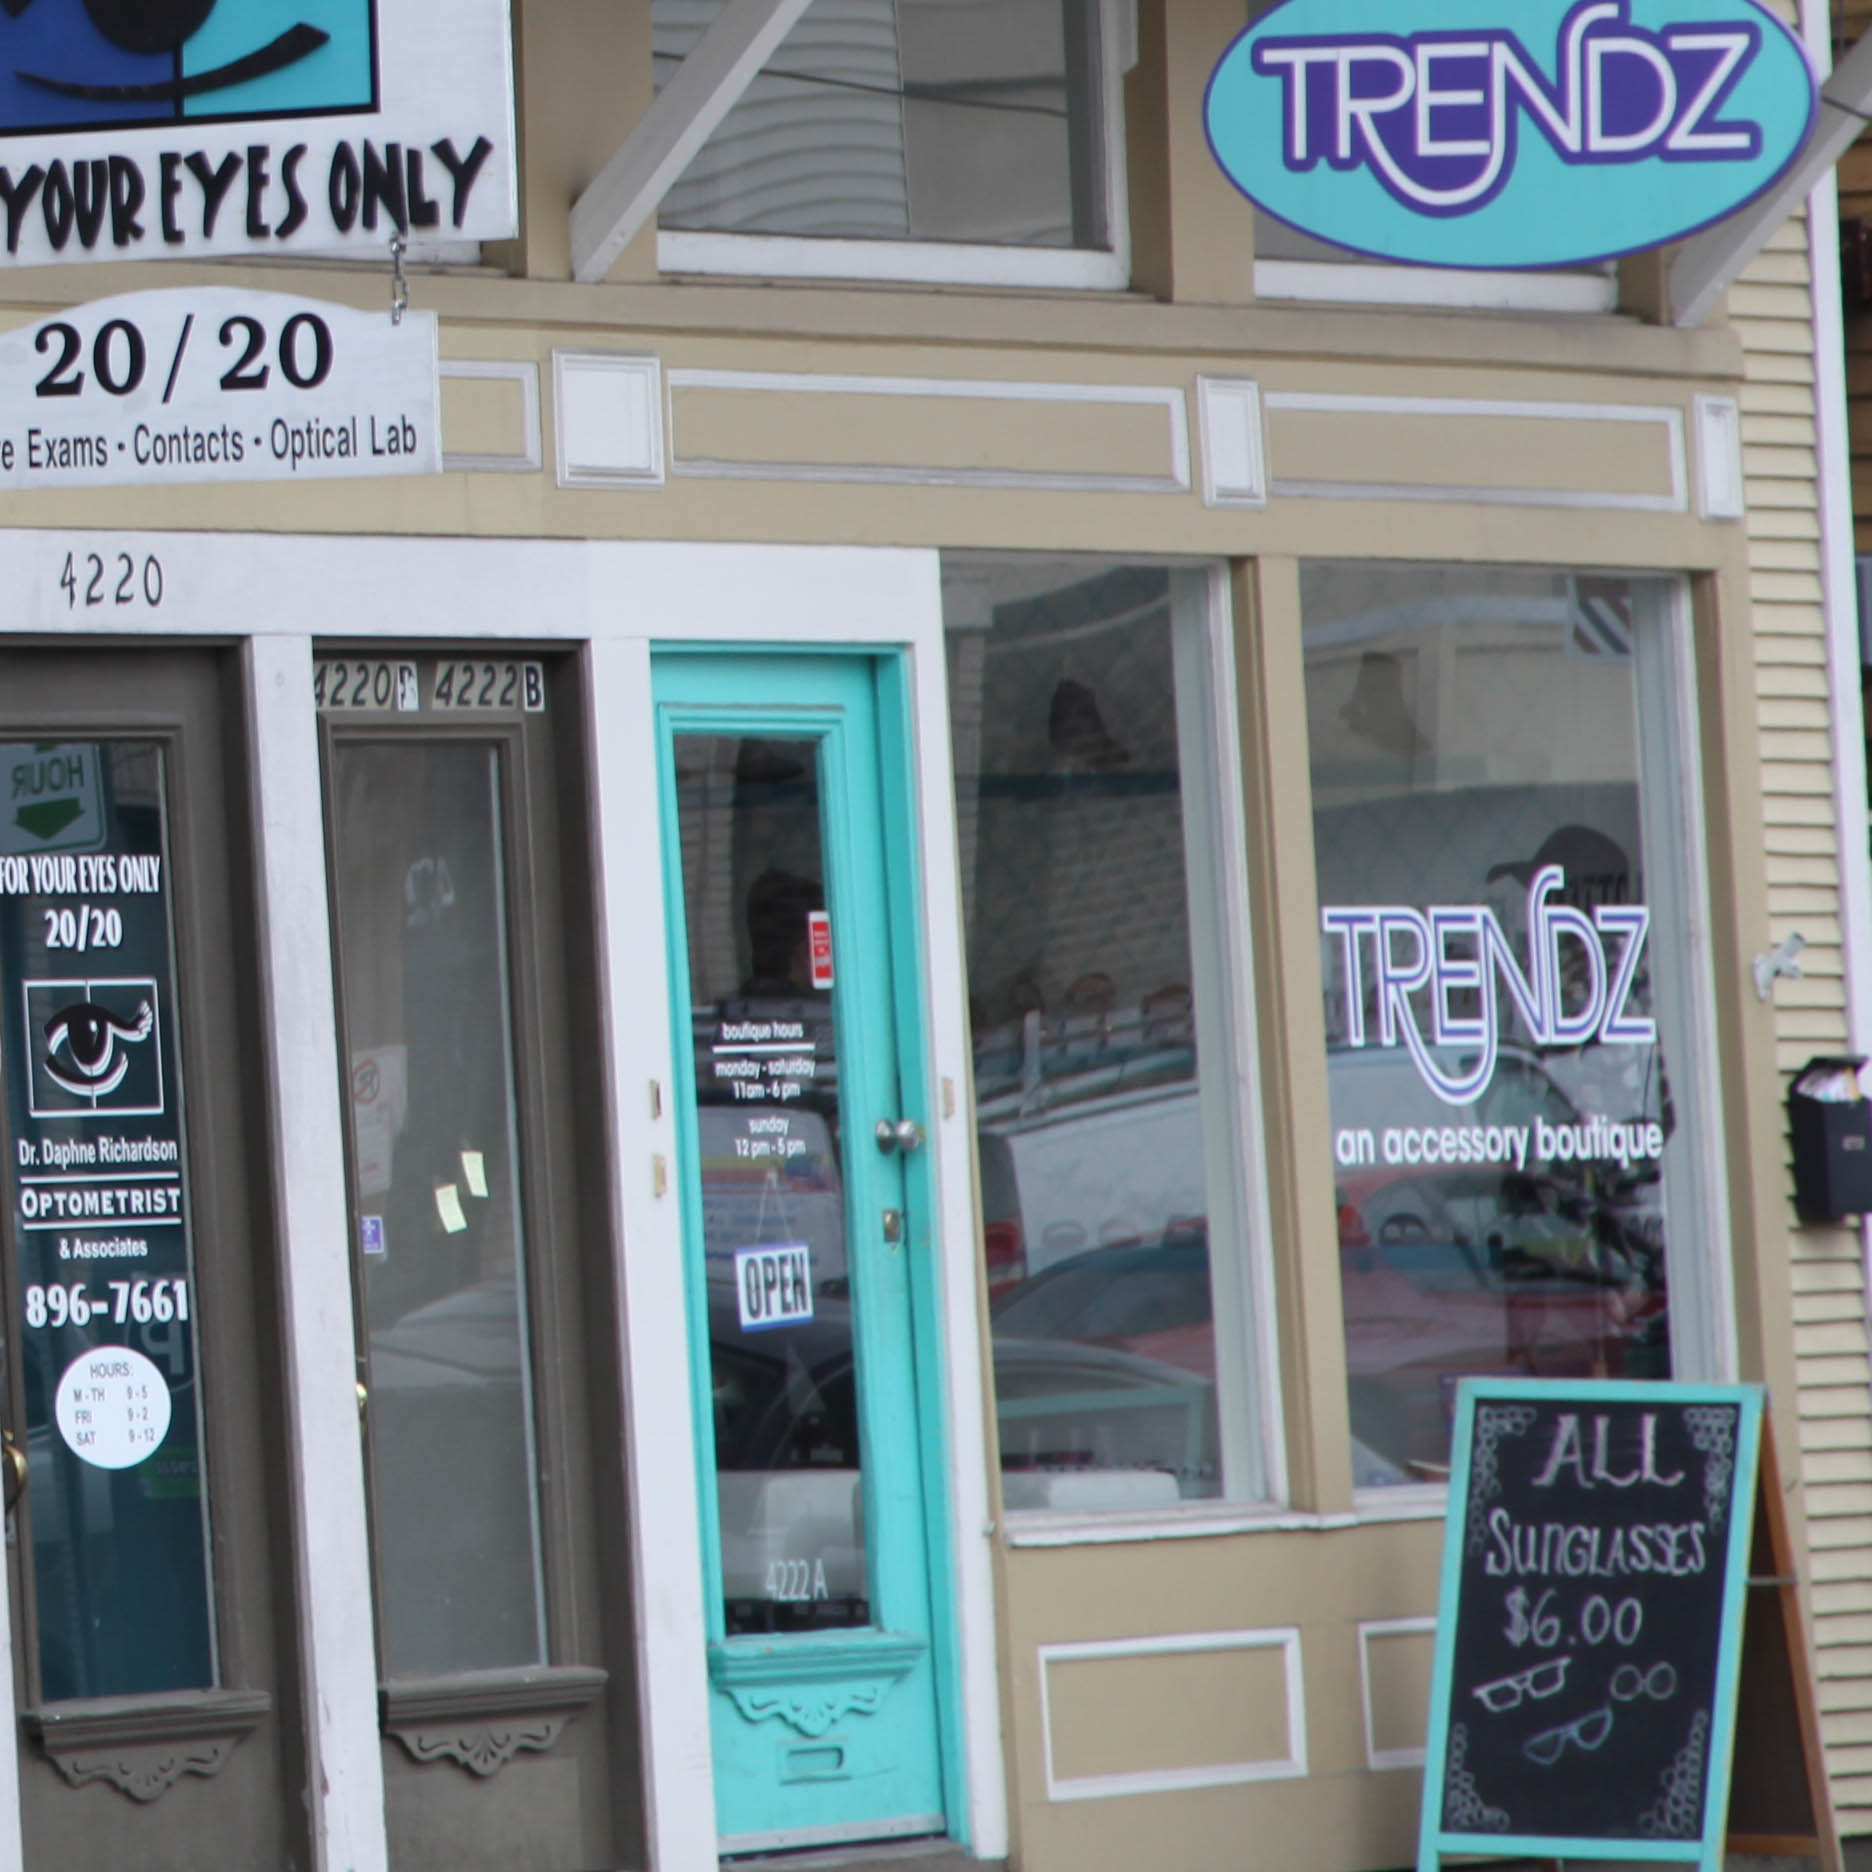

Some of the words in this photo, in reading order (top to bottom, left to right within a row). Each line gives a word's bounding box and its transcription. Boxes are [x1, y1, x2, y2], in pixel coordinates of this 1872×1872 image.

[1259, 0, 1753, 208] TRENDZ
[159, 143, 309, 244] EYES
[328, 135, 494, 231] ONLY
[28, 428, 108, 469] Exams
[134, 423, 244, 465] Contacts
[271, 415, 358, 471] Optical
[371, 414, 417, 455] Lab
[59, 551, 163, 610] 4220
[30, 856, 77, 895] YOUR
[78, 855, 117, 893] EYES
[119, 855, 160, 893] ONLY
[44, 904, 123, 952] 20/20
[1322, 864, 1656, 1106] TRENDZ
[772, 1020, 803, 1039] hours
[715, 1059, 761, 1080] monday
[768, 1058, 816, 1078] saturday
[747, 1116, 790, 1135] sunday
[1336, 1128, 1375, 1166] an
[1382, 1125, 1529, 1171] accessory
[1534, 1115, 1664, 1170] boutique
[18, 1139, 41, 1167] Dr.
[42, 1138, 97, 1170] Daphne
[98, 1136, 178, 1163] Richardson
[21, 1187, 181, 1218] OPTOMETRIST
[59, 1238, 71, 1259] &
[72, 1236, 148, 1259] Associates
[25, 1279, 189, 1328] 896-7661
[745, 1252, 808, 1320] OPEN
[1533, 1412, 1684, 1490] ALL
[1504, 1585, 1643, 1648] $6.00
